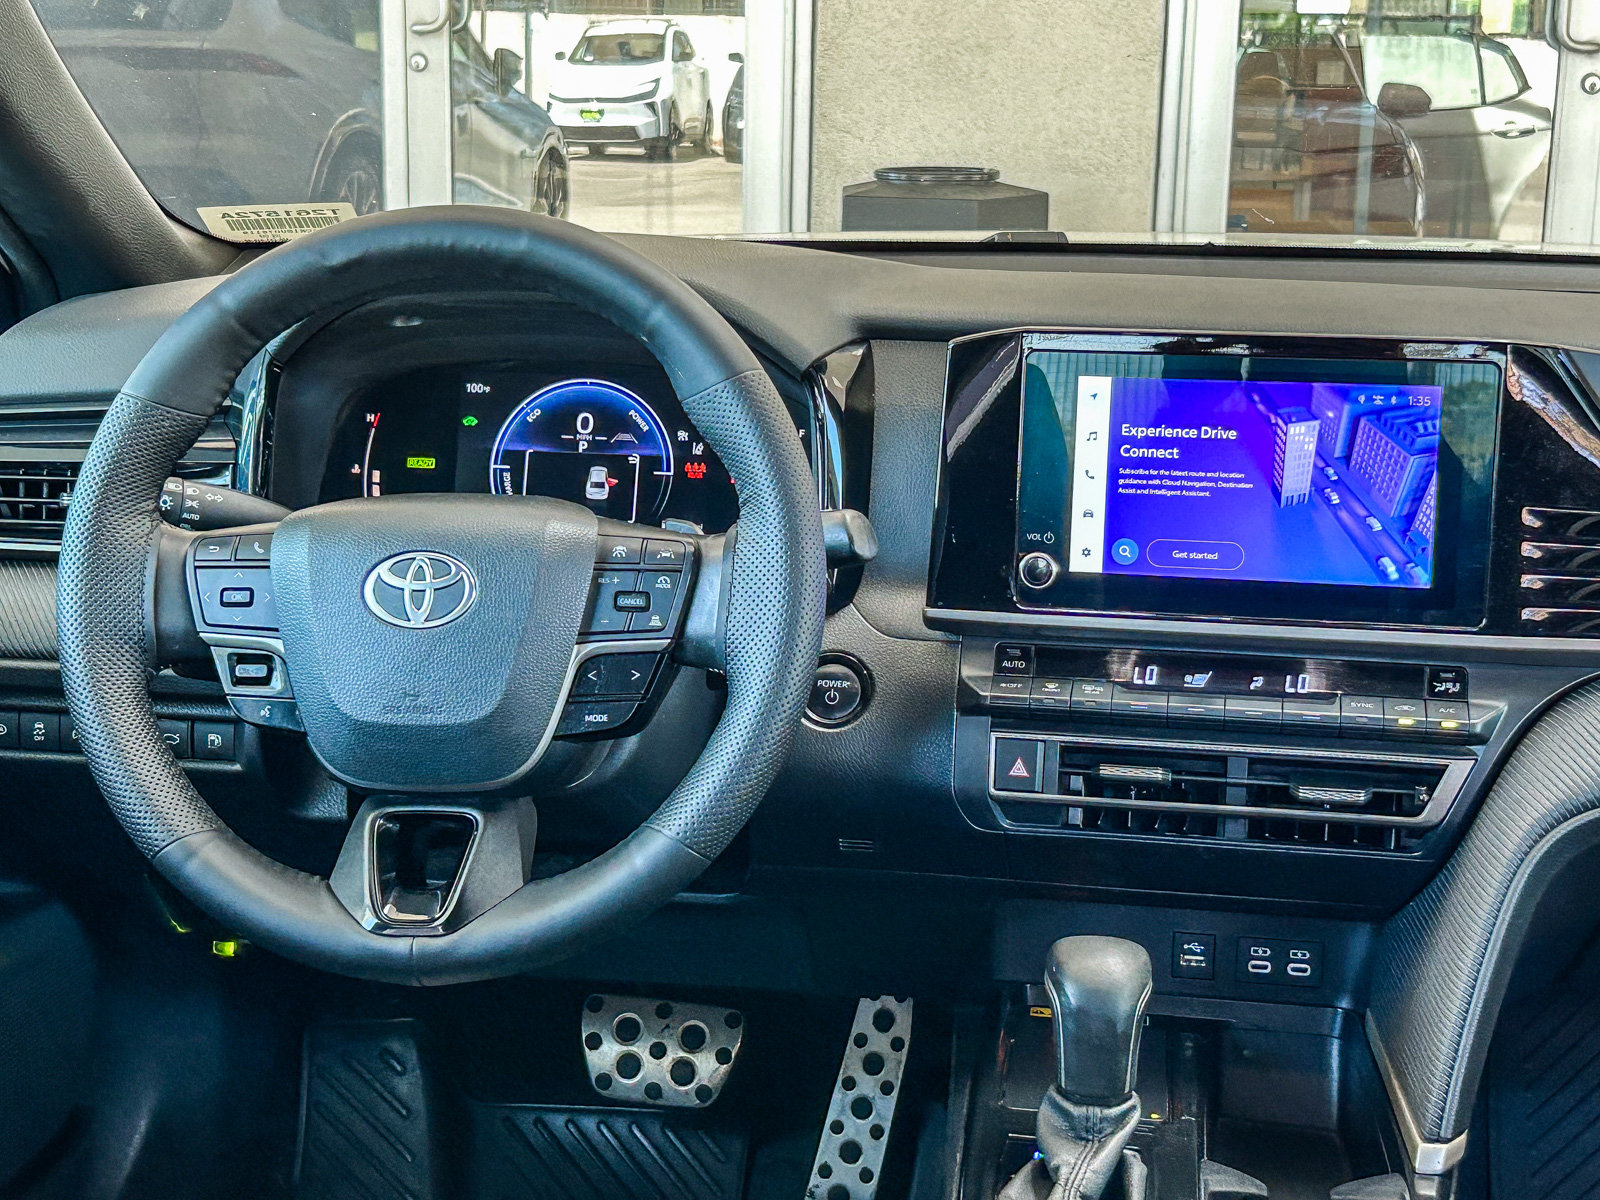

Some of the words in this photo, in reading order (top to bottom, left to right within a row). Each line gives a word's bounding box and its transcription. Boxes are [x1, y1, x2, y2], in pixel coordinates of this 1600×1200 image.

[1407, 395, 1432, 407] 1:35
[366, 413, 375, 423] H
[526, 408, 542, 423] ECO
[628, 409, 650, 433] POWER
[1121, 423, 1198, 439] Experience
[1200, 425, 1238, 440] Drive
[578, 441, 588, 453] P
[1119, 444, 1180, 459] Connect
[407, 458, 435, 469] READY
[1118, 467, 1149, 475] Subscribe
[1171, 469, 1188, 477] latest
[1220, 471, 1245, 479] location
[1118, 478, 1147, 487] guidance
[1162, 479, 1181, 487] Cloud
[1181, 480, 1217, 489] Navigation,
[1217, 481, 1254, 489] Destination
[1117, 487, 1136, 495] Assist
[1150, 488, 1181, 497] Intelligent
[1181, 489, 1212, 497] Assistant.
[181, 512, 200, 521] AUTO
[1026, 532, 1042, 541] VOL
[1172, 550, 1188, 559] Get
[1189, 550, 1219, 560] started
[619, 597, 645, 605] CANCEL
[1002, 660, 1026, 669] AUTO
[1133, 665, 1159, 686] LO
[817, 679, 848, 689] POWER
[1284, 673, 1311, 694] LO
[1438, 707, 1456, 715] A/C
[584, 714, 609, 723] MODE
